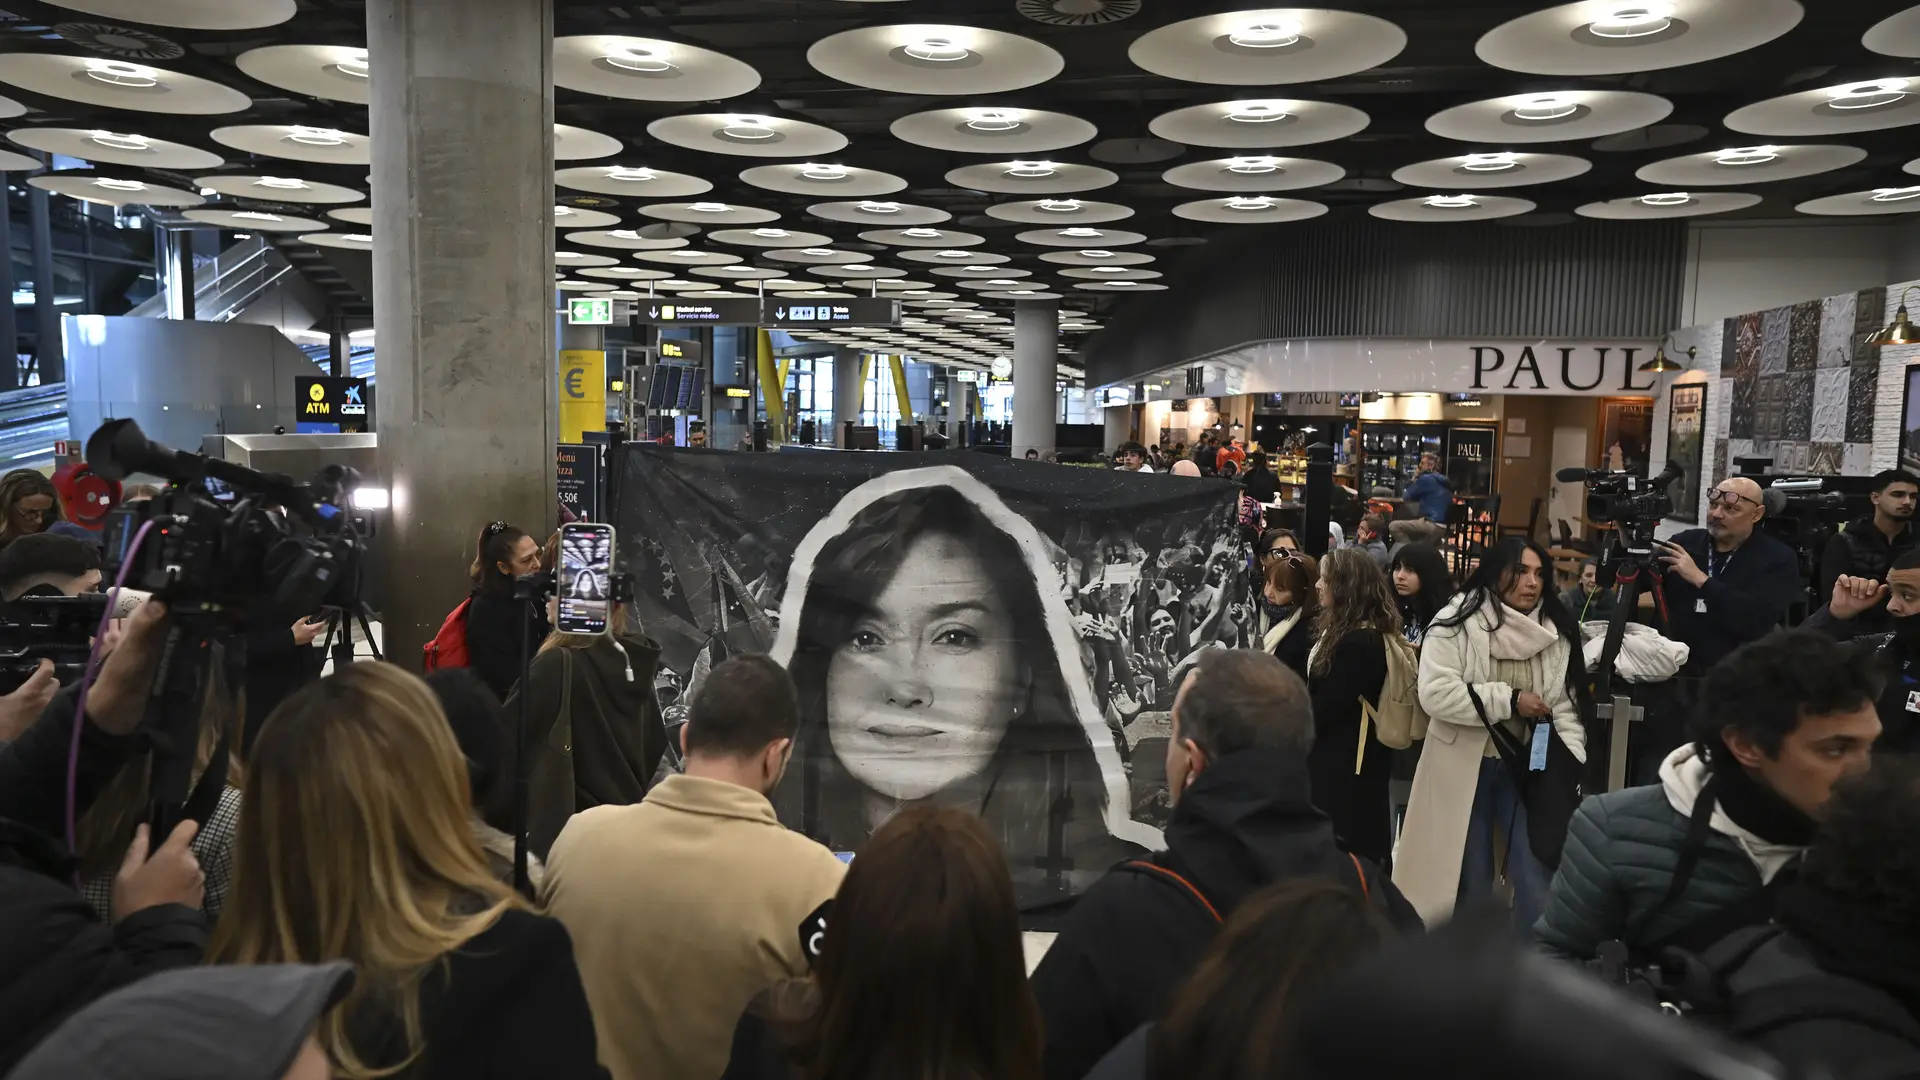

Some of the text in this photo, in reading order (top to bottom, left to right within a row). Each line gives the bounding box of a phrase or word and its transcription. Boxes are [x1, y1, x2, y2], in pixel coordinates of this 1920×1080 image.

[1468, 346, 1656, 391] PAUL
[1298, 391, 1332, 405] PAUL
[306, 402, 330, 414] ATM
[1457, 443, 1482, 457] PAUL
